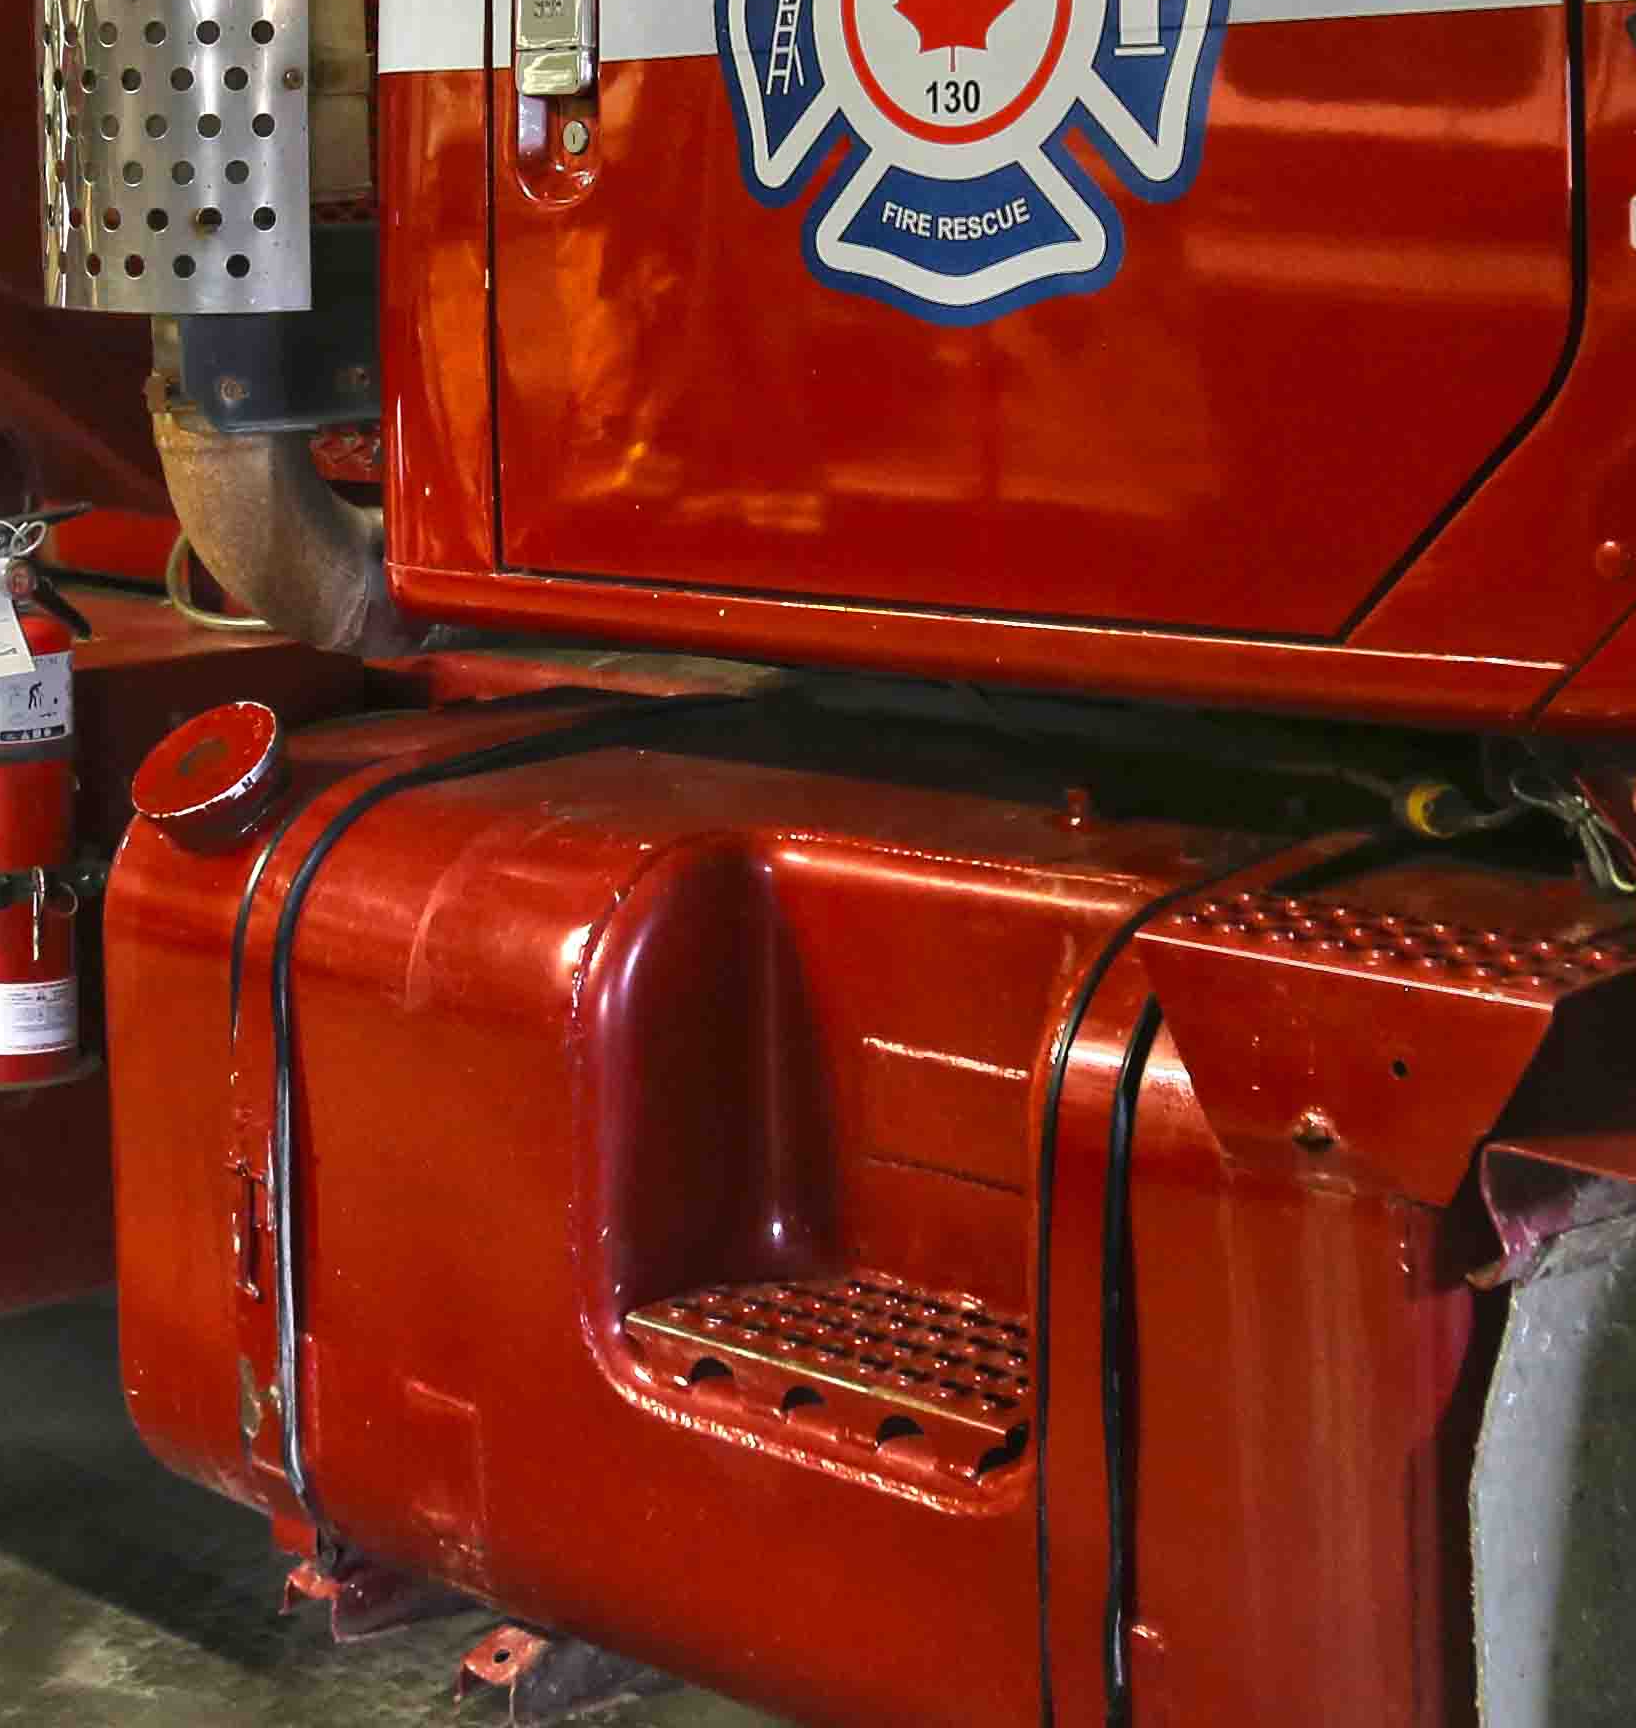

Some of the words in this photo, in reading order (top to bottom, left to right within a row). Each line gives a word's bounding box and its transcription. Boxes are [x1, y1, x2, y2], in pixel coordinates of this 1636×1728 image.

[925, 80, 981, 114] 130
[882, 201, 933, 238] FIRE
[937, 197, 1031, 241] RESCUE
